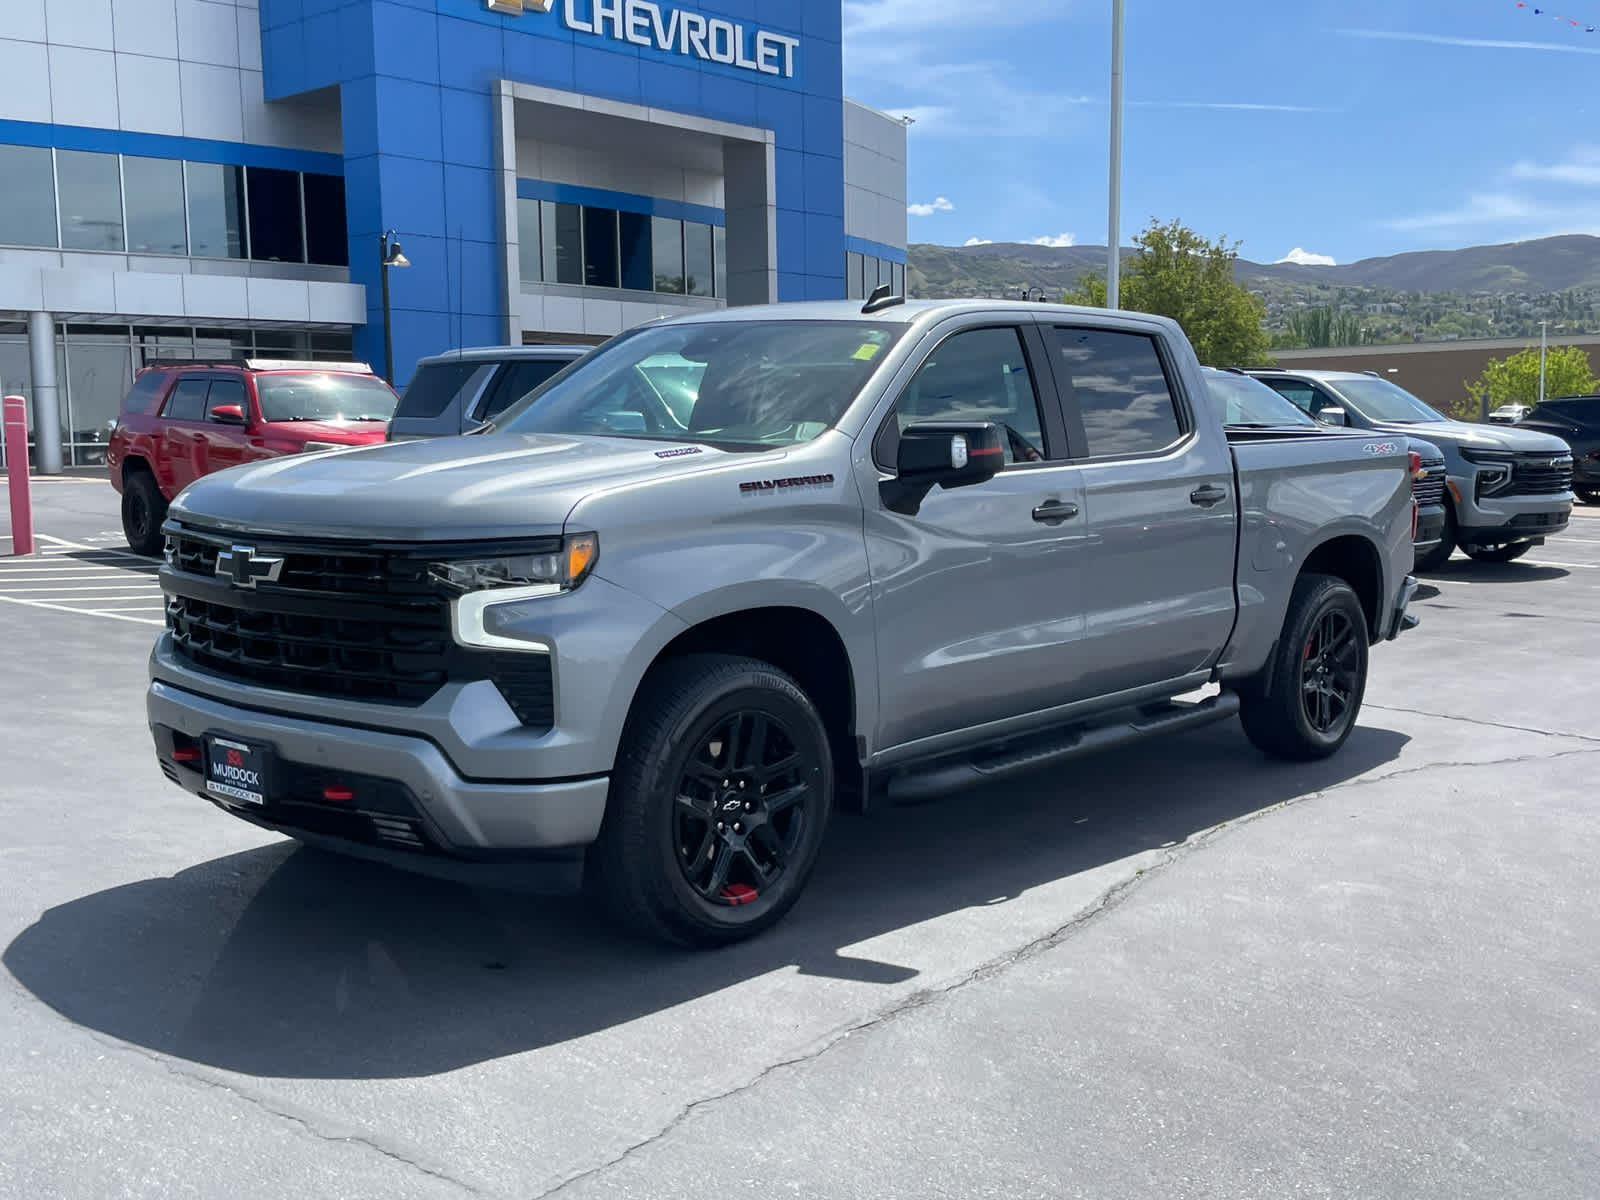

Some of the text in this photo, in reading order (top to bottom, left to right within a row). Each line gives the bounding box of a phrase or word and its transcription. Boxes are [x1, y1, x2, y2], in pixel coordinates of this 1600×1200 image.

[564, 0, 799, 77] CHEVROLET
[739, 474, 834, 492] SILVERADO
[213, 762, 259, 785] MURDOCK
